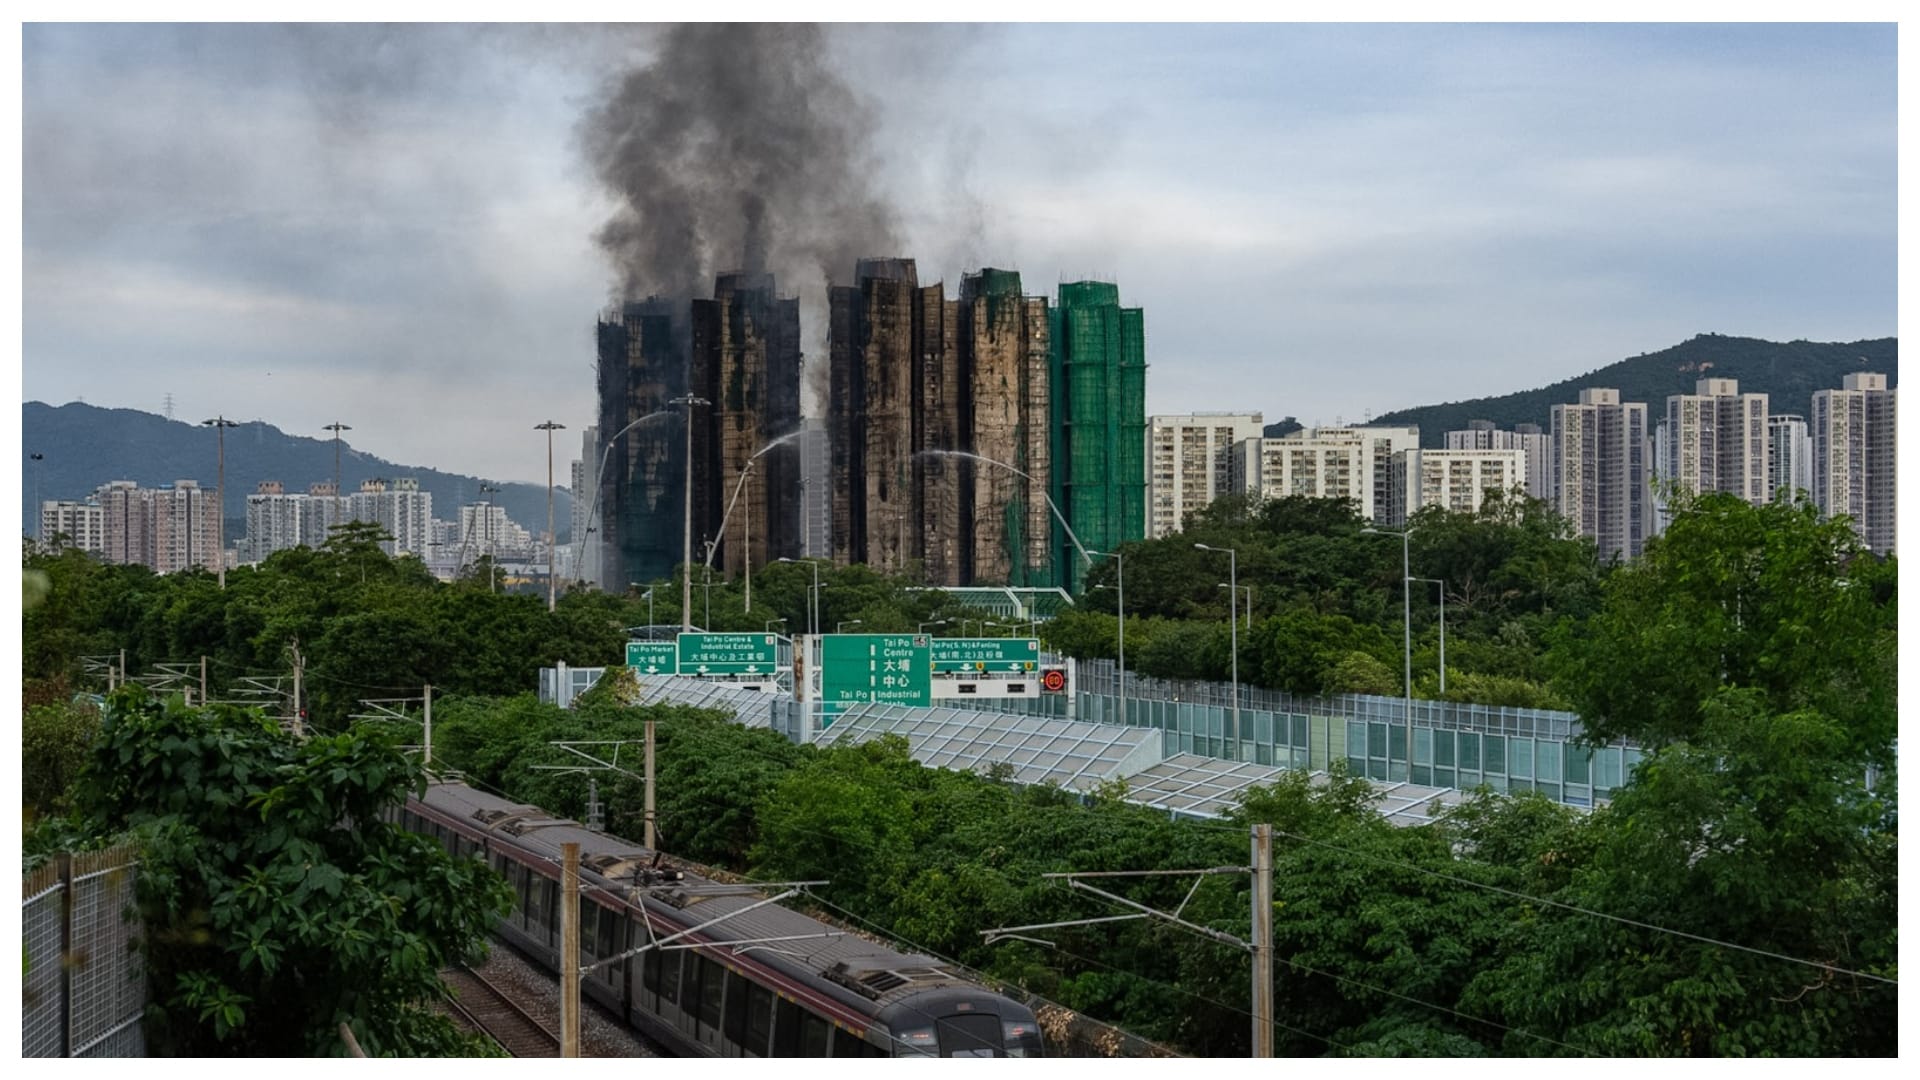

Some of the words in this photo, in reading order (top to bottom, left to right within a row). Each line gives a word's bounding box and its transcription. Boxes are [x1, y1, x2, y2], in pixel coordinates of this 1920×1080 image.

[883, 638, 896, 647] Tai
[898, 638, 910, 647] Po
[883, 648, 914, 657] Centre
[883, 659, 911, 672] 大埔
[883, 674, 910, 688] 中心
[840, 690, 853, 699] Tai
[856, 690, 868, 699] Po
[877, 690, 921, 698] Industrial
